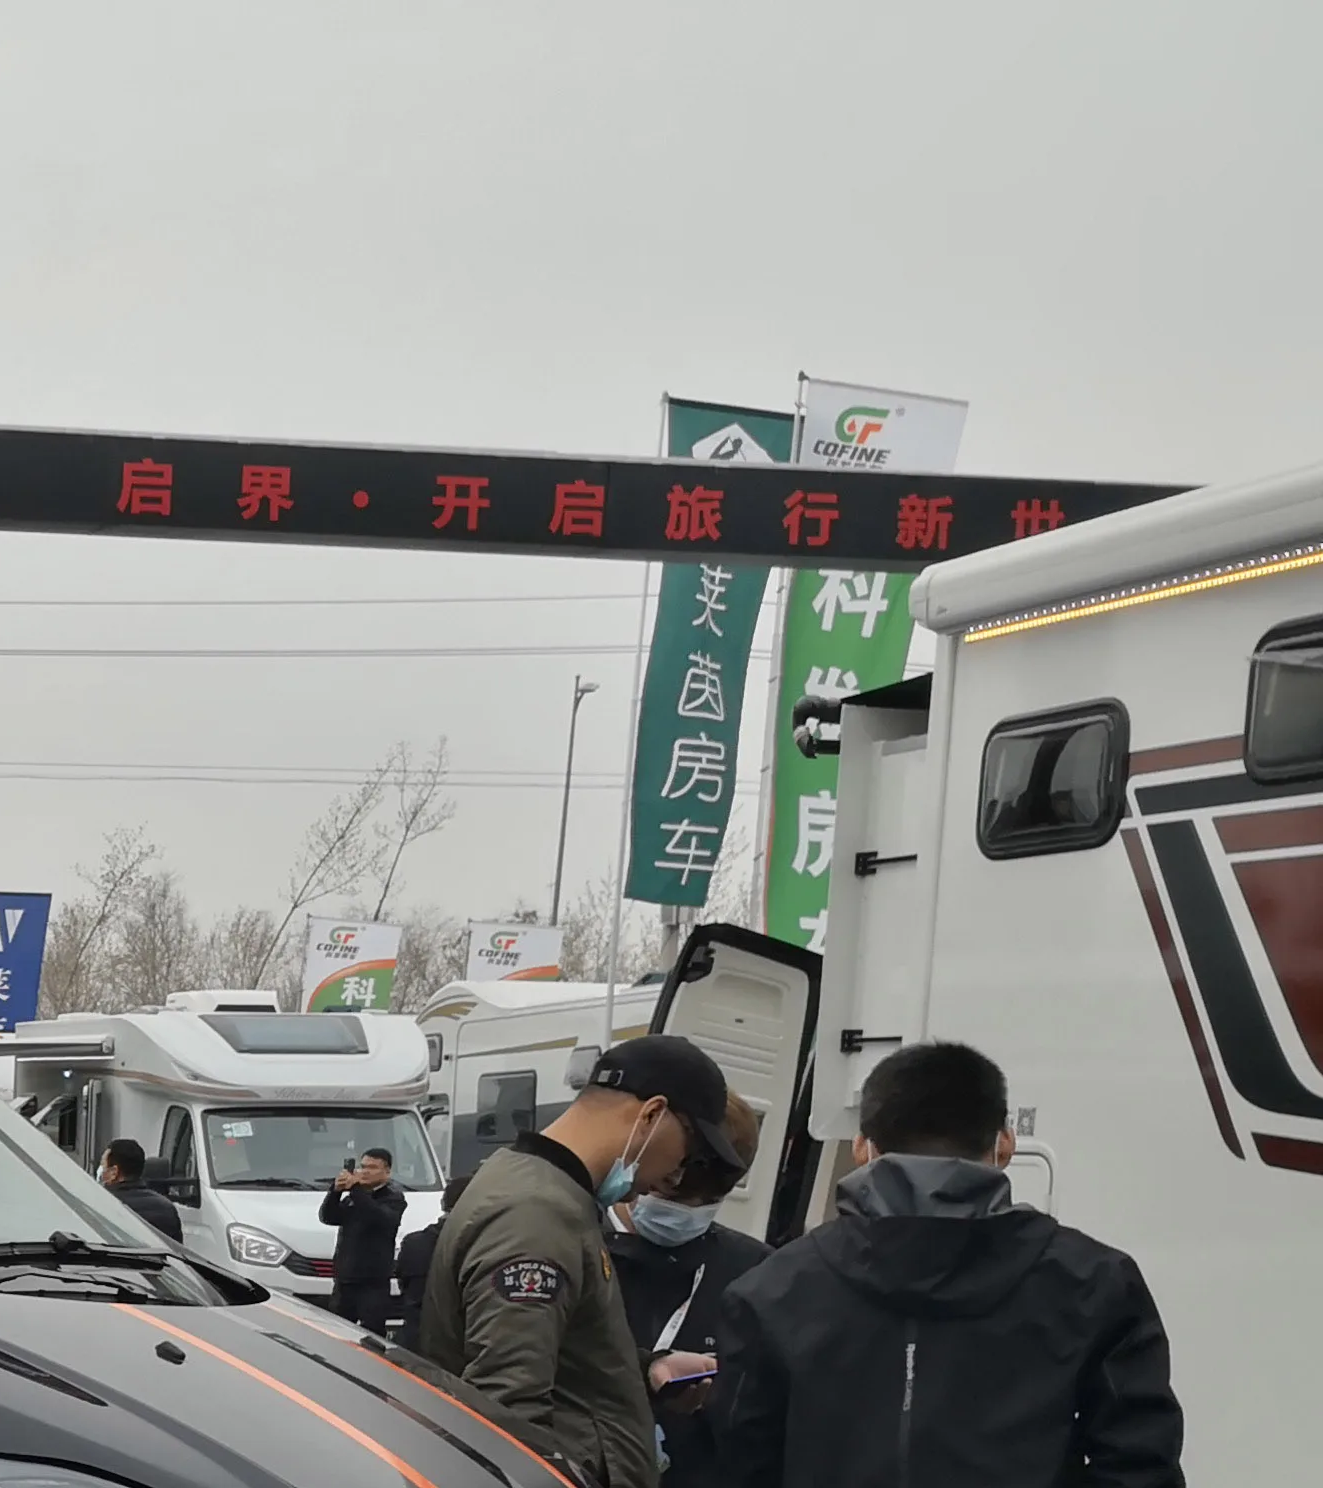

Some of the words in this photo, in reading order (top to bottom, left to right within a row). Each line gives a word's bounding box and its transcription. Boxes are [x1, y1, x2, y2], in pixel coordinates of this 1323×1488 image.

[813, 439, 891, 464] COFINE
[654, 562, 733, 885] 莱茵房车
[341, 976, 377, 1008] 科
